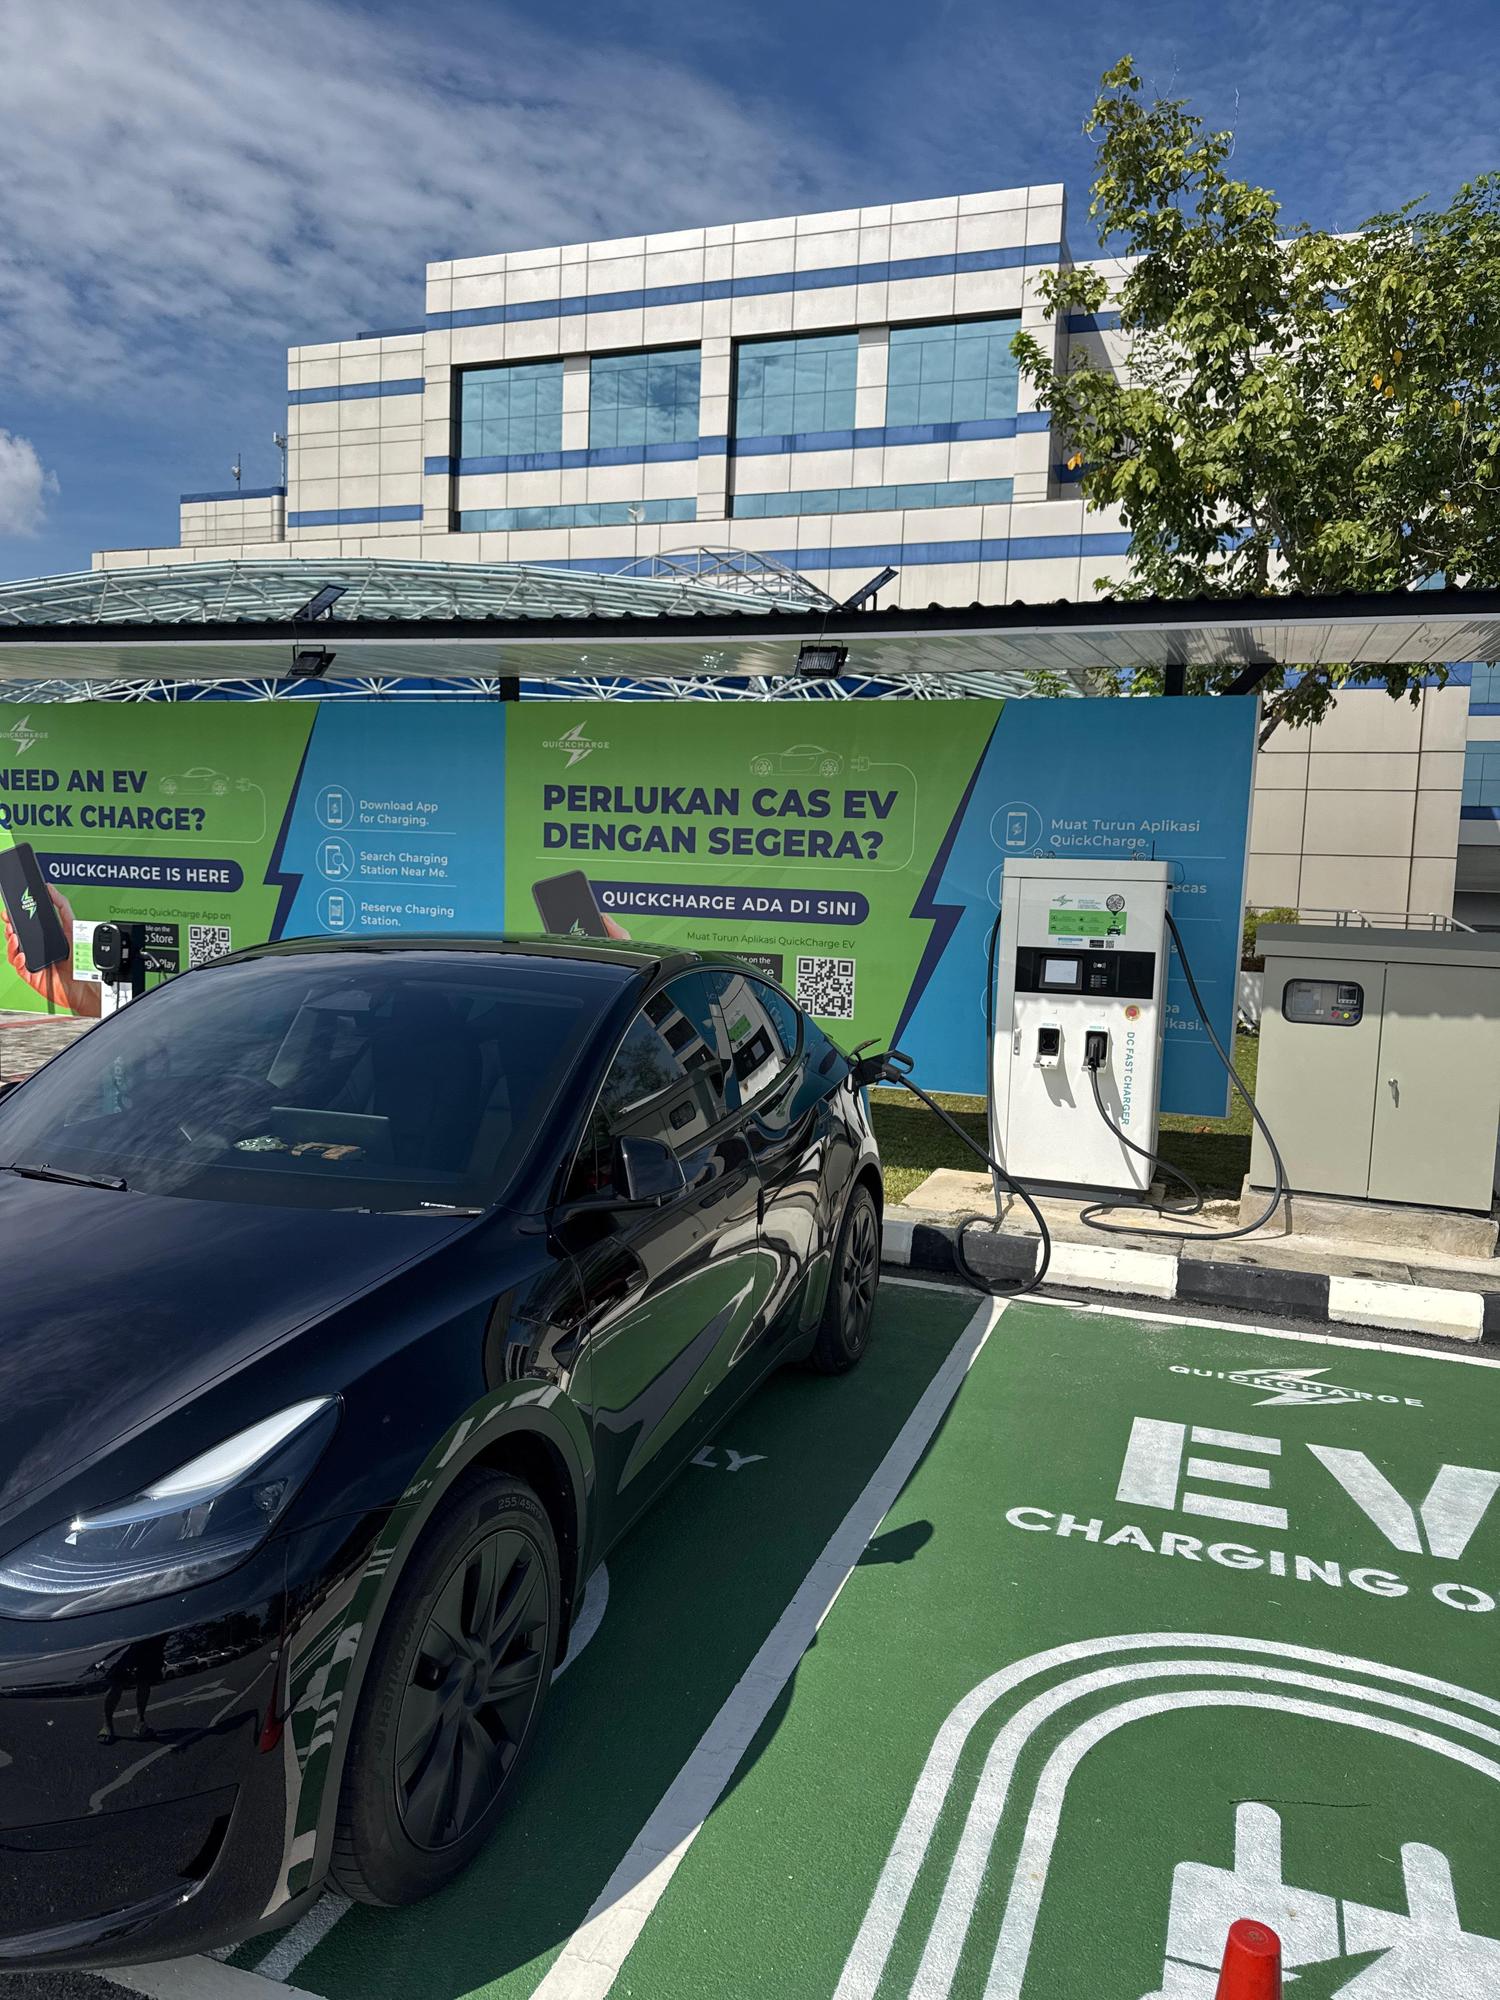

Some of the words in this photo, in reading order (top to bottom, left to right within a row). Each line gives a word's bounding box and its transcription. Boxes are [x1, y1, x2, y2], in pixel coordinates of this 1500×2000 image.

[542, 741, 610, 749] QUICKCHARGE
[0, 769, 60, 791] NEED
[66, 770, 104, 792] AN
[113, 771, 147, 793] EV
[360, 800, 413, 811] Download
[417, 802, 438, 813] App
[543, 784, 738, 816] PERLUKAN
[752, 788, 830, 818] CAS
[844, 790, 898, 820] EV
[0, 803, 73, 830] QUICK
[80, 805, 206, 832] CHARGE?
[360, 813, 373, 824] for
[377, 814, 430, 827] Charging.
[1052, 819, 1087, 832] Muat
[1092, 819, 1136, 832] Turun
[1140, 819, 1200, 835] Aplikasi
[543, 822, 696, 854] DENGAN
[708, 827, 883, 860] SEGERA?
[1050, 833, 1149, 848] QuickCharge.
[360, 851, 396, 862] Search
[398, 852, 448, 865] Charging
[49, 862, 161, 881] QUICKCHARGE
[166, 867, 181, 882] IS
[186, 868, 230, 883] HERE
[360, 865, 398, 875] Station
[401, 866, 426, 877] Near
[429, 867, 448, 878] Me.
[361, 902, 402, 913] Reserve
[405, 904, 454, 917] Charging
[602, 890, 736, 911] QUICKCHARGE
[742, 896, 784, 913] ADA
[790, 899, 811, 915] DI
[817, 899, 857, 916] SINI
[110, 906, 147, 915] Download
[150, 908, 200, 919] QuickCharge
[202, 911, 218, 920] App
[361, 915, 401, 927] Station.
[150, 932, 174, 944] Store
[688, 932, 710, 941] Muat
[712, 933, 739, 943] Turun
[741, 934, 776, 945] Aplikasi
[779, 936, 840, 949] QuickCharge
[842, 940, 856, 949] EV
[760, 956, 771, 964] the
[1126, 1032, 1135, 1046] DC
[1124, 1048, 1134, 1073] FAST
[1121, 1075, 1133, 1125] CHARGER
[1168, 1365, 1425, 1407] QUICKCHARGE
[1115, 1416, 1500, 1560] EV
[1005, 1506, 1409, 1597] CHARGING
